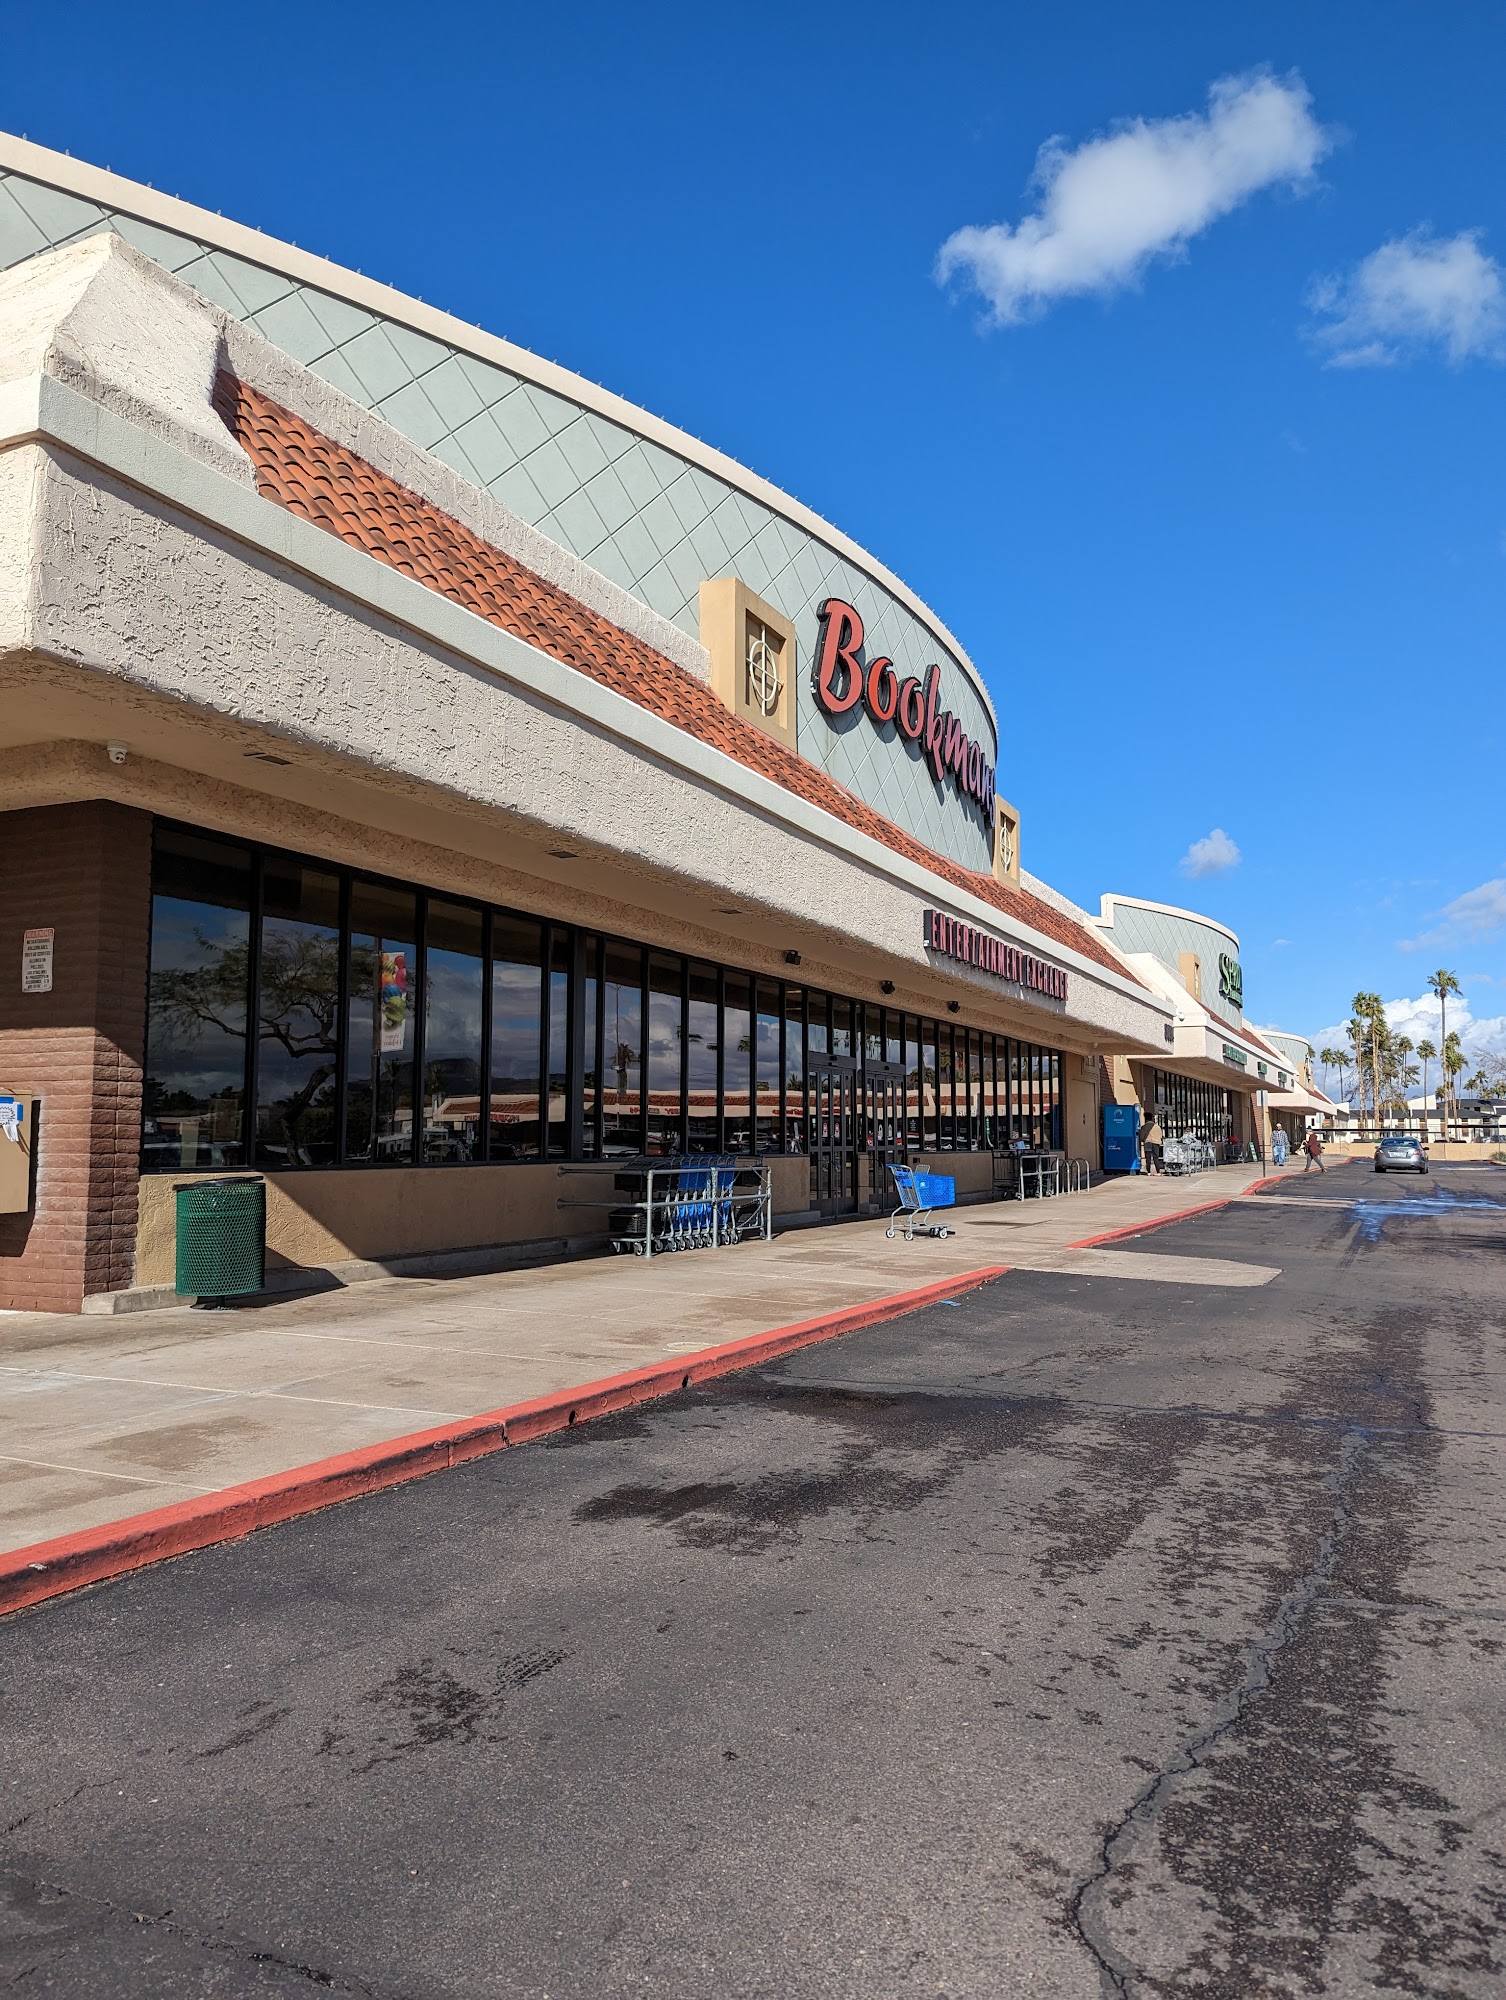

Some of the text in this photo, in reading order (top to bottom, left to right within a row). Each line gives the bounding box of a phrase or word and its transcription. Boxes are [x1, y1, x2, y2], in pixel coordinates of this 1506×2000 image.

[812, 598, 996, 829] Bookmans
[927, 910, 1068, 1001] ENTERTAINMENT EXCHANGE
